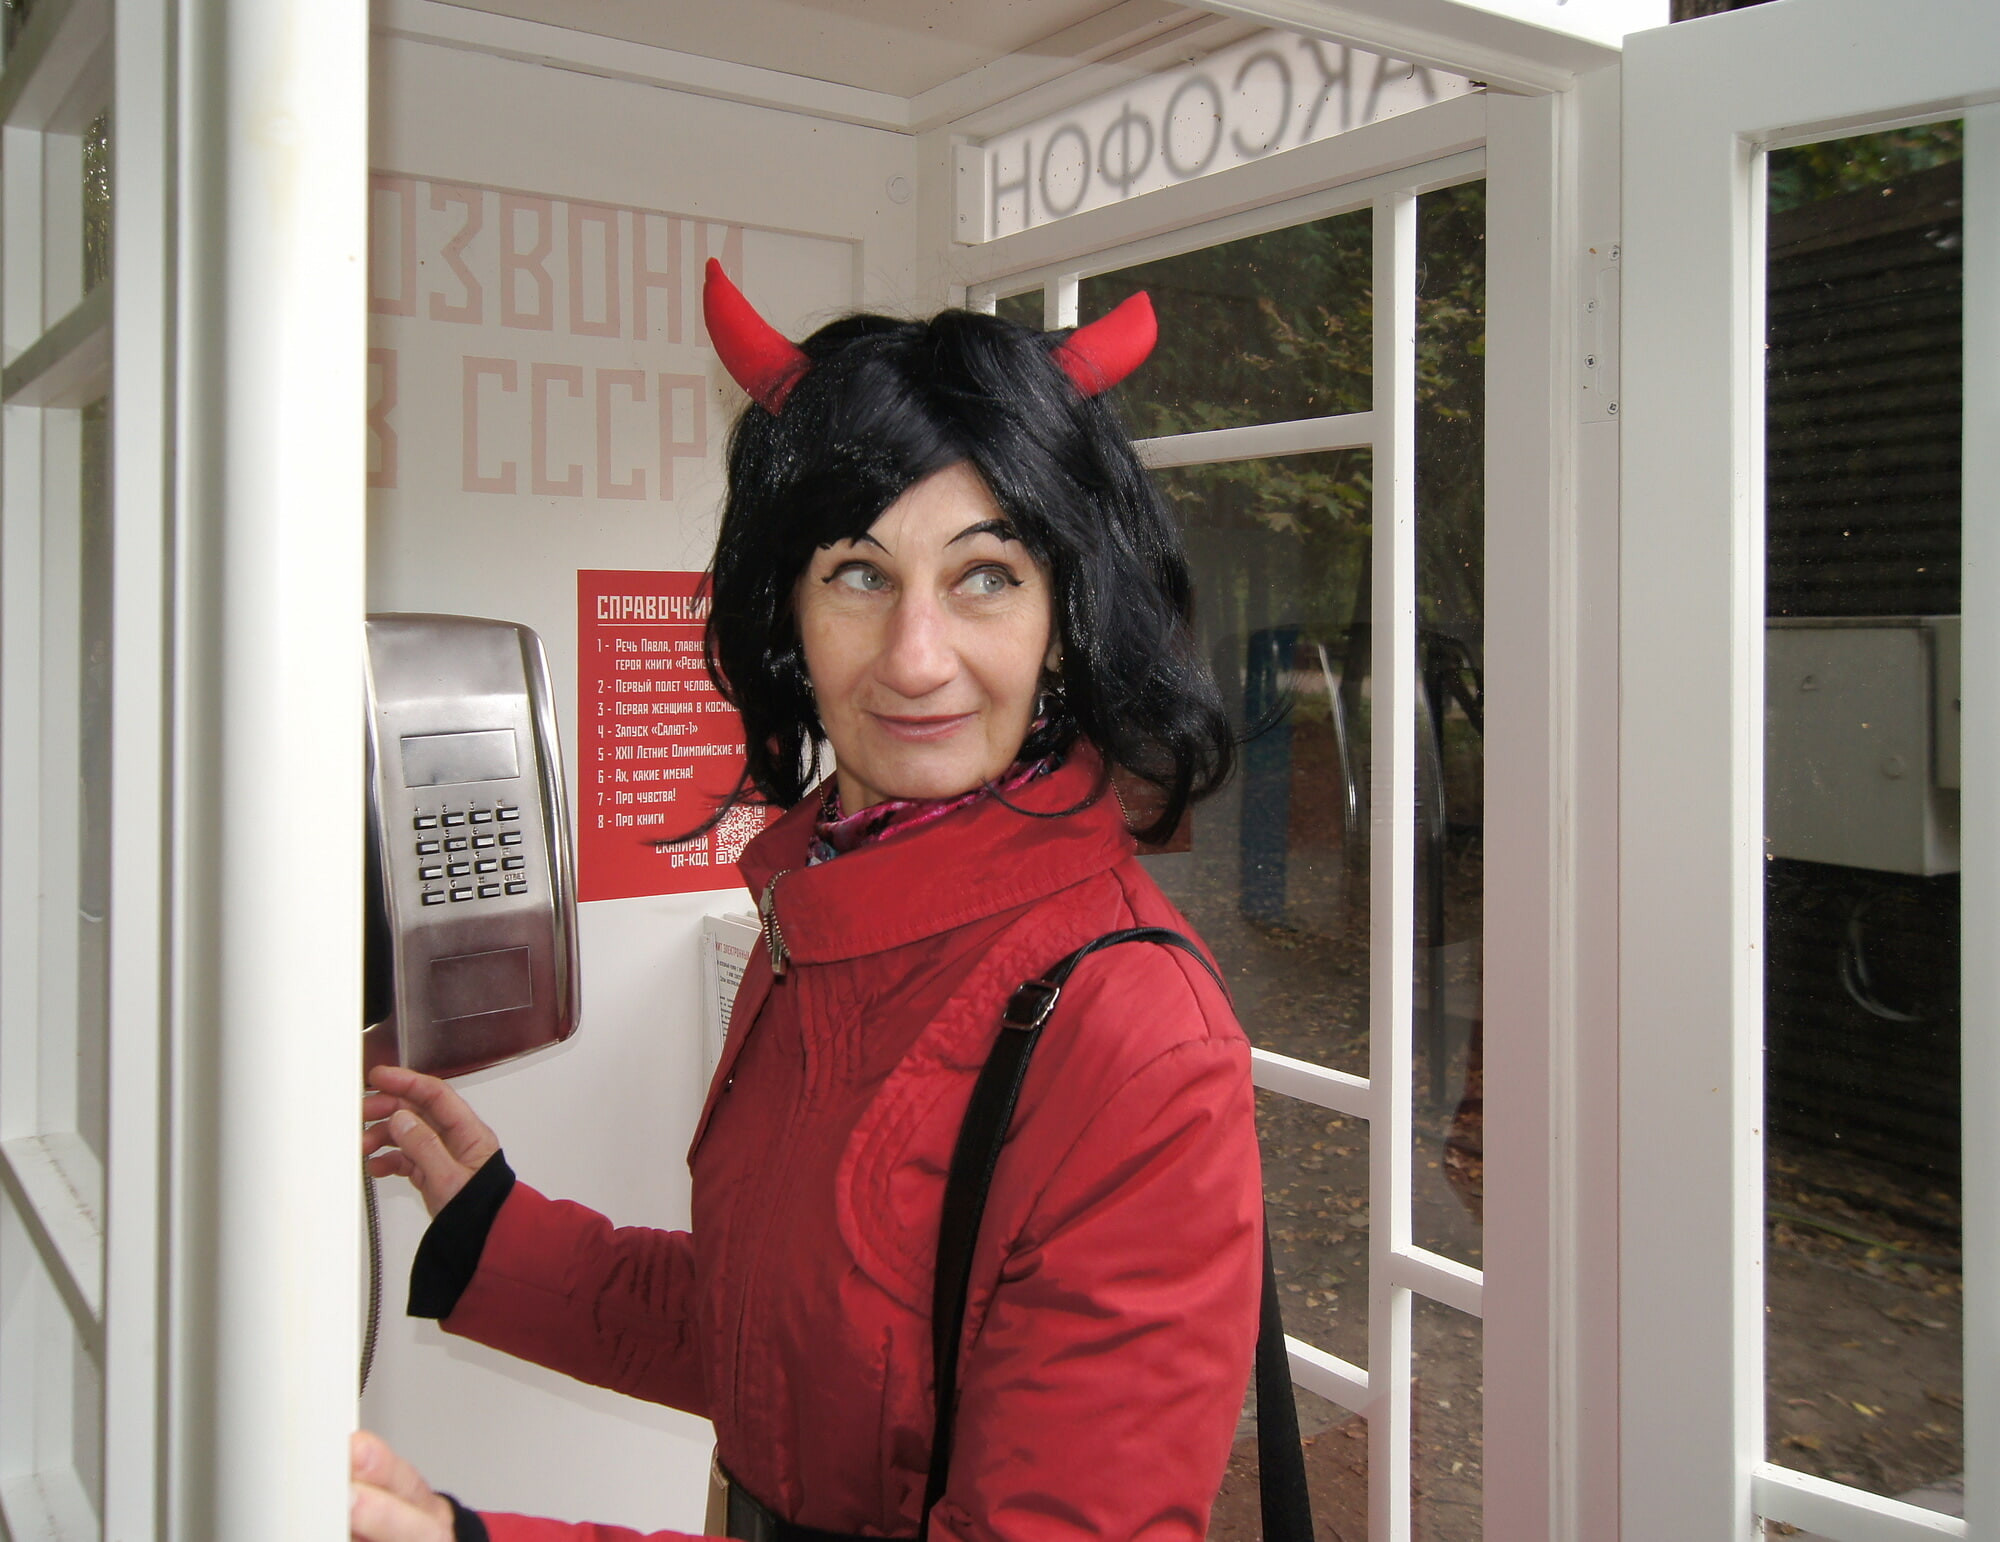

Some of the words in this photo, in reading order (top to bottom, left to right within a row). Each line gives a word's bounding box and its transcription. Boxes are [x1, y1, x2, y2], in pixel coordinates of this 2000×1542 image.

[462, 355, 707, 501] СССР
[597, 638, 602, 653] 1
[615, 639, 638, 652] Речь
[640, 639, 672, 652] Павла,
[615, 660, 642, 670] героя
[645, 659, 673, 670] книги
[597, 679, 604, 694] 2
[615, 679, 652, 692] Первый
[655, 681, 681, 692] полет
[597, 702, 604, 717] 3
[615, 702, 649, 715] Первая
[651, 703, 694, 714] женщина
[597, 724, 604, 739] 4
[615, 724, 649, 737] Запуск
[597, 747, 604, 761] 5
[636, 746, 669, 759] Летние
[671, 743, 733, 757] Олимпийские
[597, 769, 604, 784] 6
[615, 769, 630, 782] Ах,
[632, 770, 661, 781] какие
[662, 765, 694, 779] имена!
[597, 792, 604, 806] 7
[615, 791, 634, 804] Про
[636, 788, 676, 803] чувства!
[597, 814, 604, 829] 8
[615, 813, 634, 826] Про
[636, 813, 665, 825] книги
[670, 853, 709, 869] QR-КОД
